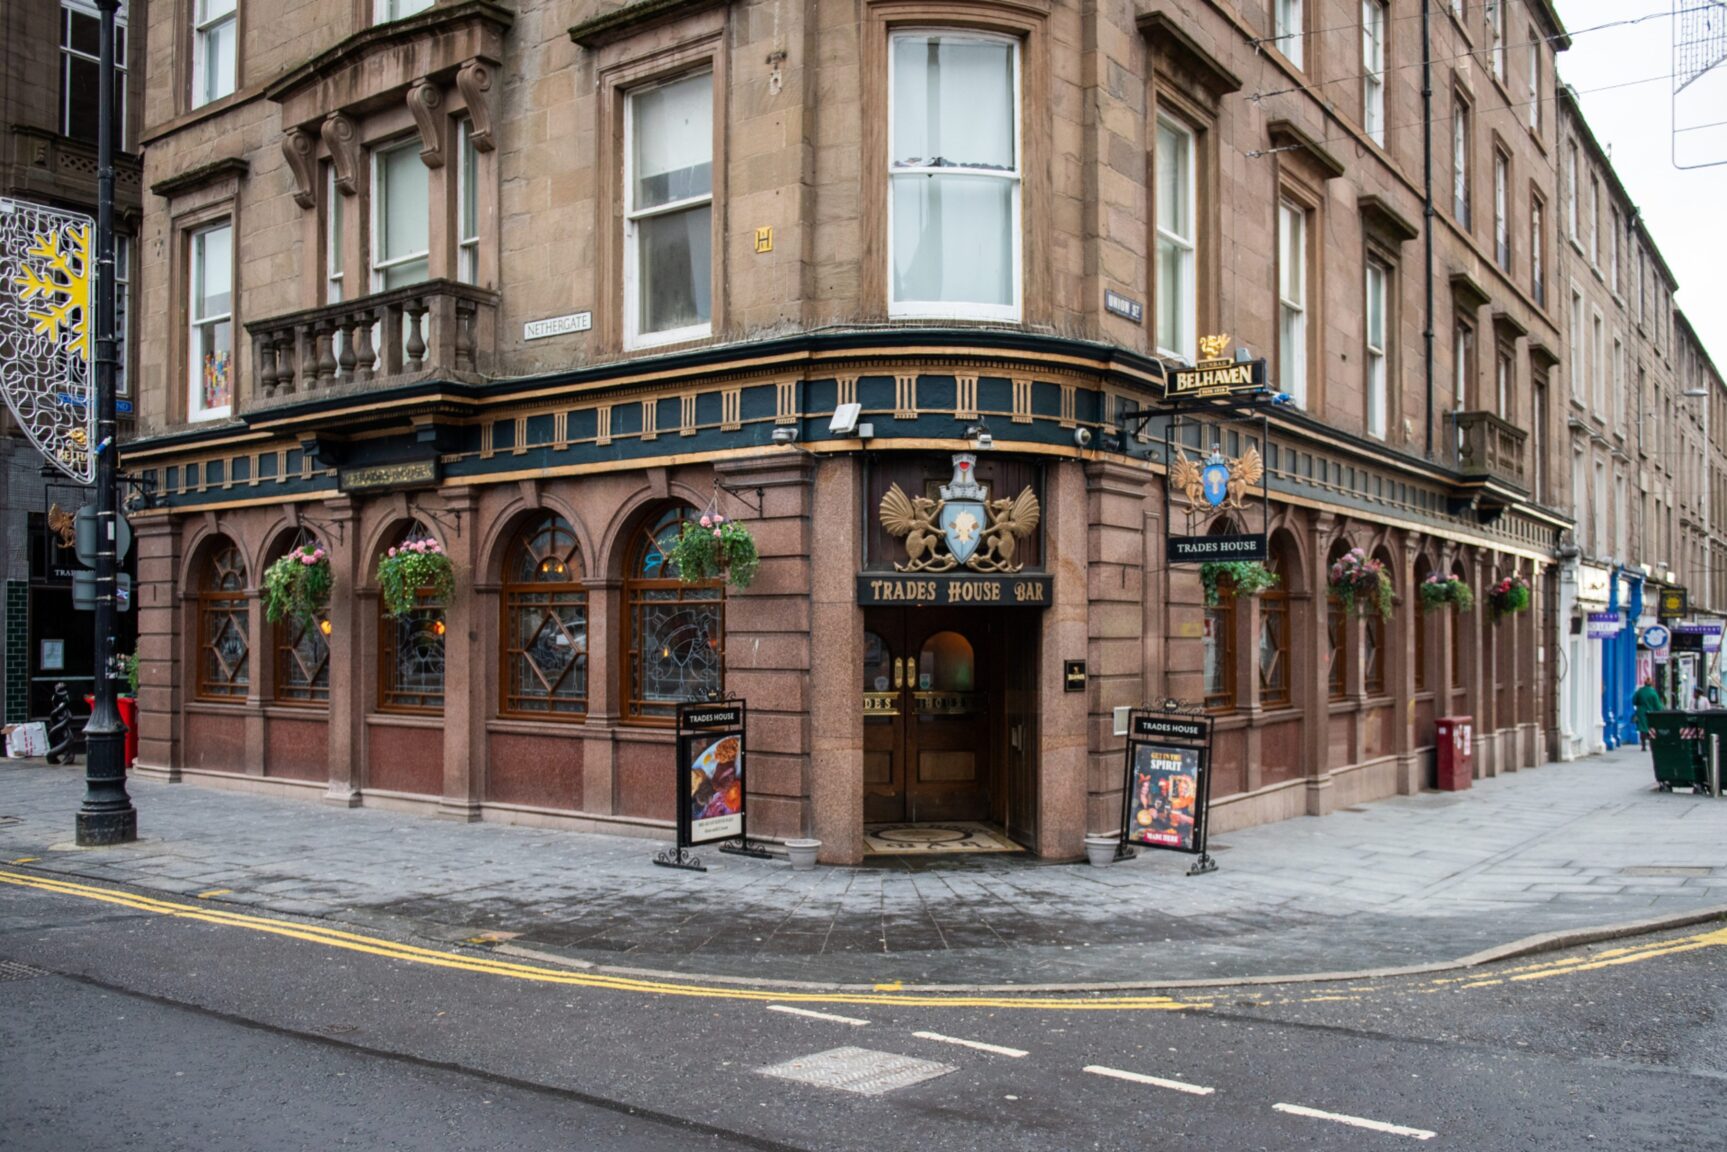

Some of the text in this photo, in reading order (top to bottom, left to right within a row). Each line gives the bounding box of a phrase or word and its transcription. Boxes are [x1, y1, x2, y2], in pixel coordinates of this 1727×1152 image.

[1108, 293, 1130, 314] UNION
[527, 314, 588, 336] NETHERGATE
[1176, 364, 1252, 391] BELHAVEN
[1177, 540, 1257, 553] TRADES HOUSE
[871, 579, 1044, 602] TRADES HOUSE BAR
[864, 697, 892, 710] DES
[689, 712, 735, 724] TRADES HOUSE
[1143, 722, 1199, 735] TRADES HOUSE
[1150, 758, 1183, 772] SPIRIT
